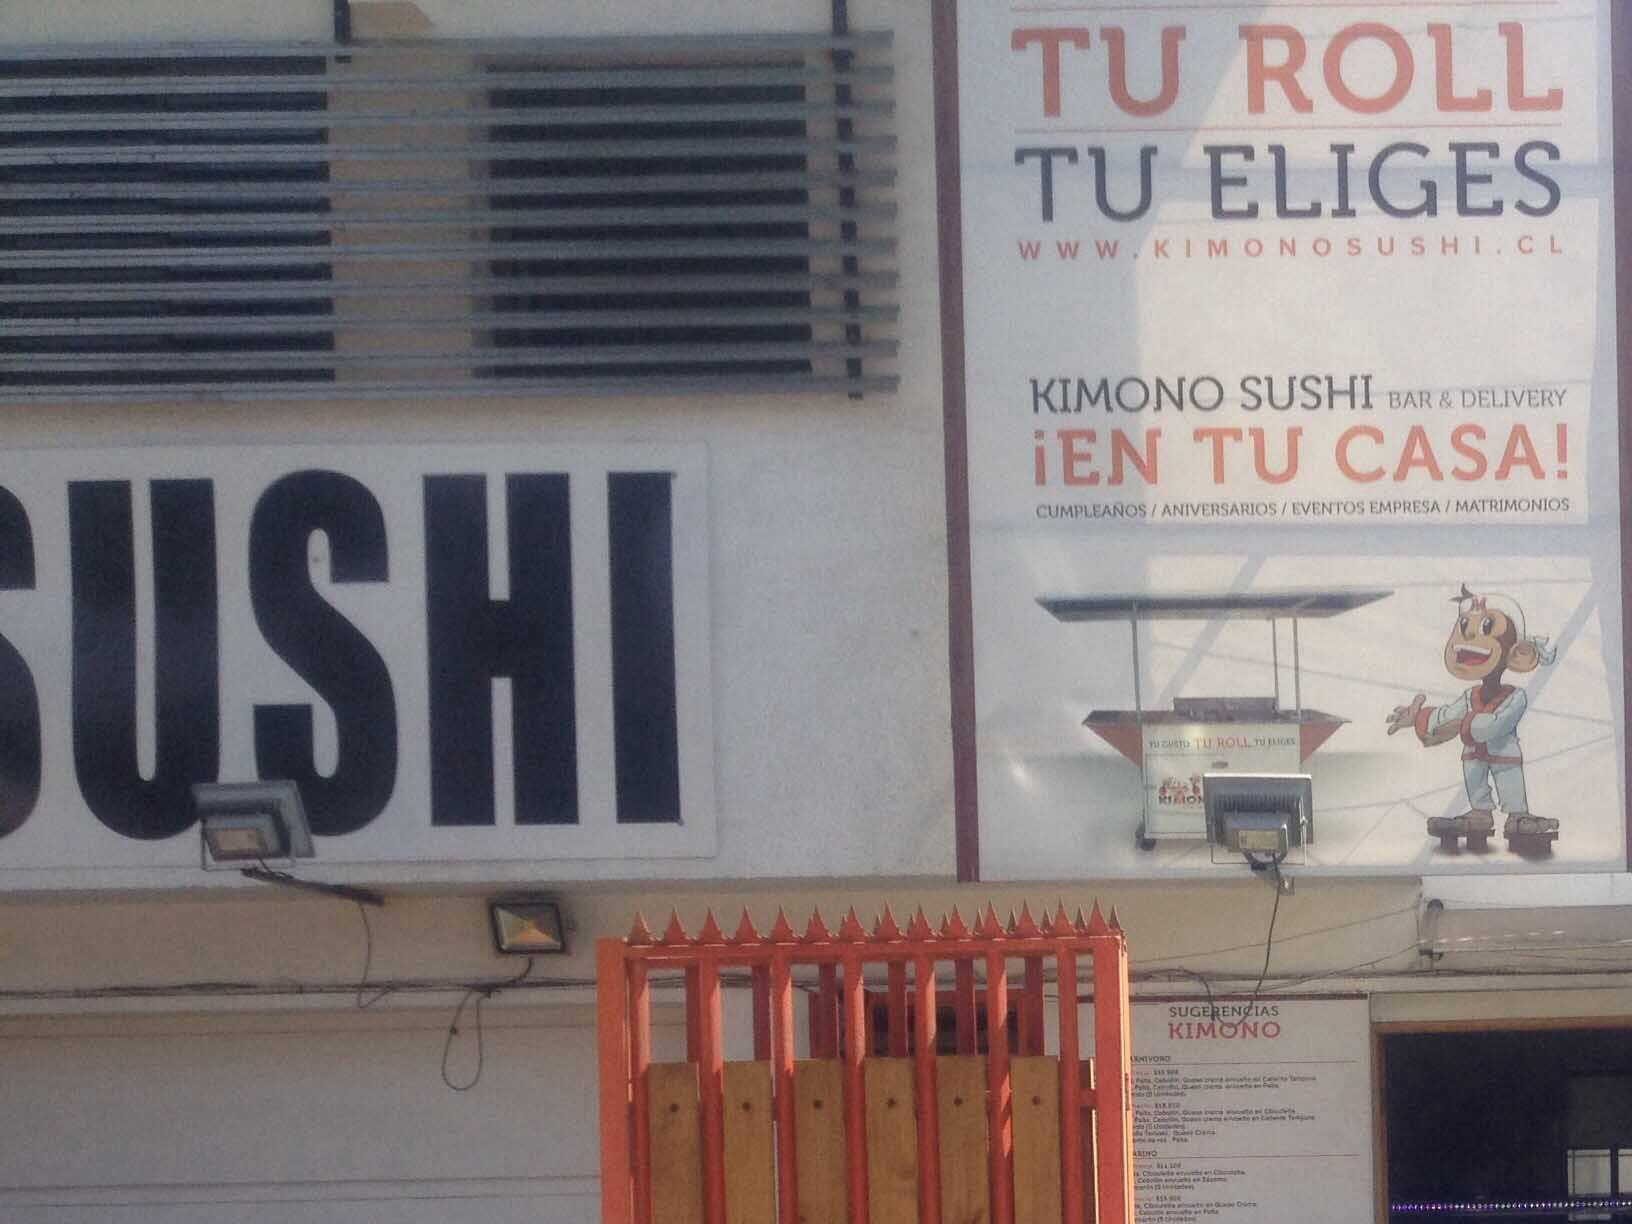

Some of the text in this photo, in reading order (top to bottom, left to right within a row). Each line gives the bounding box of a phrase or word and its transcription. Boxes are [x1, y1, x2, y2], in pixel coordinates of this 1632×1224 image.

[1011, 21, 1565, 119] TU ROLL
[1013, 140, 1563, 223] TU ELIGES
[1017, 234, 1563, 261] WWW.KIMONOSUSHI.CL
[1029, 374, 1567, 415] KIMONO SUSHI BAR & DELIVERY
[1193, 426, 1304, 485] TU
[1334, 423, 1569, 484] CASA!
[1035, 501, 1147, 519] CUMPLEAÑOS
[1161, 501, 1278, 517] ANIVERSARIOS
[1292, 500, 1365, 516] EVENTOS
[1369, 499, 1441, 515] EMPRESA
[1455, 497, 1570, 514] MATRIMONIOS
[0, 467, 683, 842] USHI
[1217, 736, 1249, 749] ROLL
[1169, 1005, 1279, 1018] SUGERENCIAS
[1168, 1021, 1281, 1040] KIMONO
